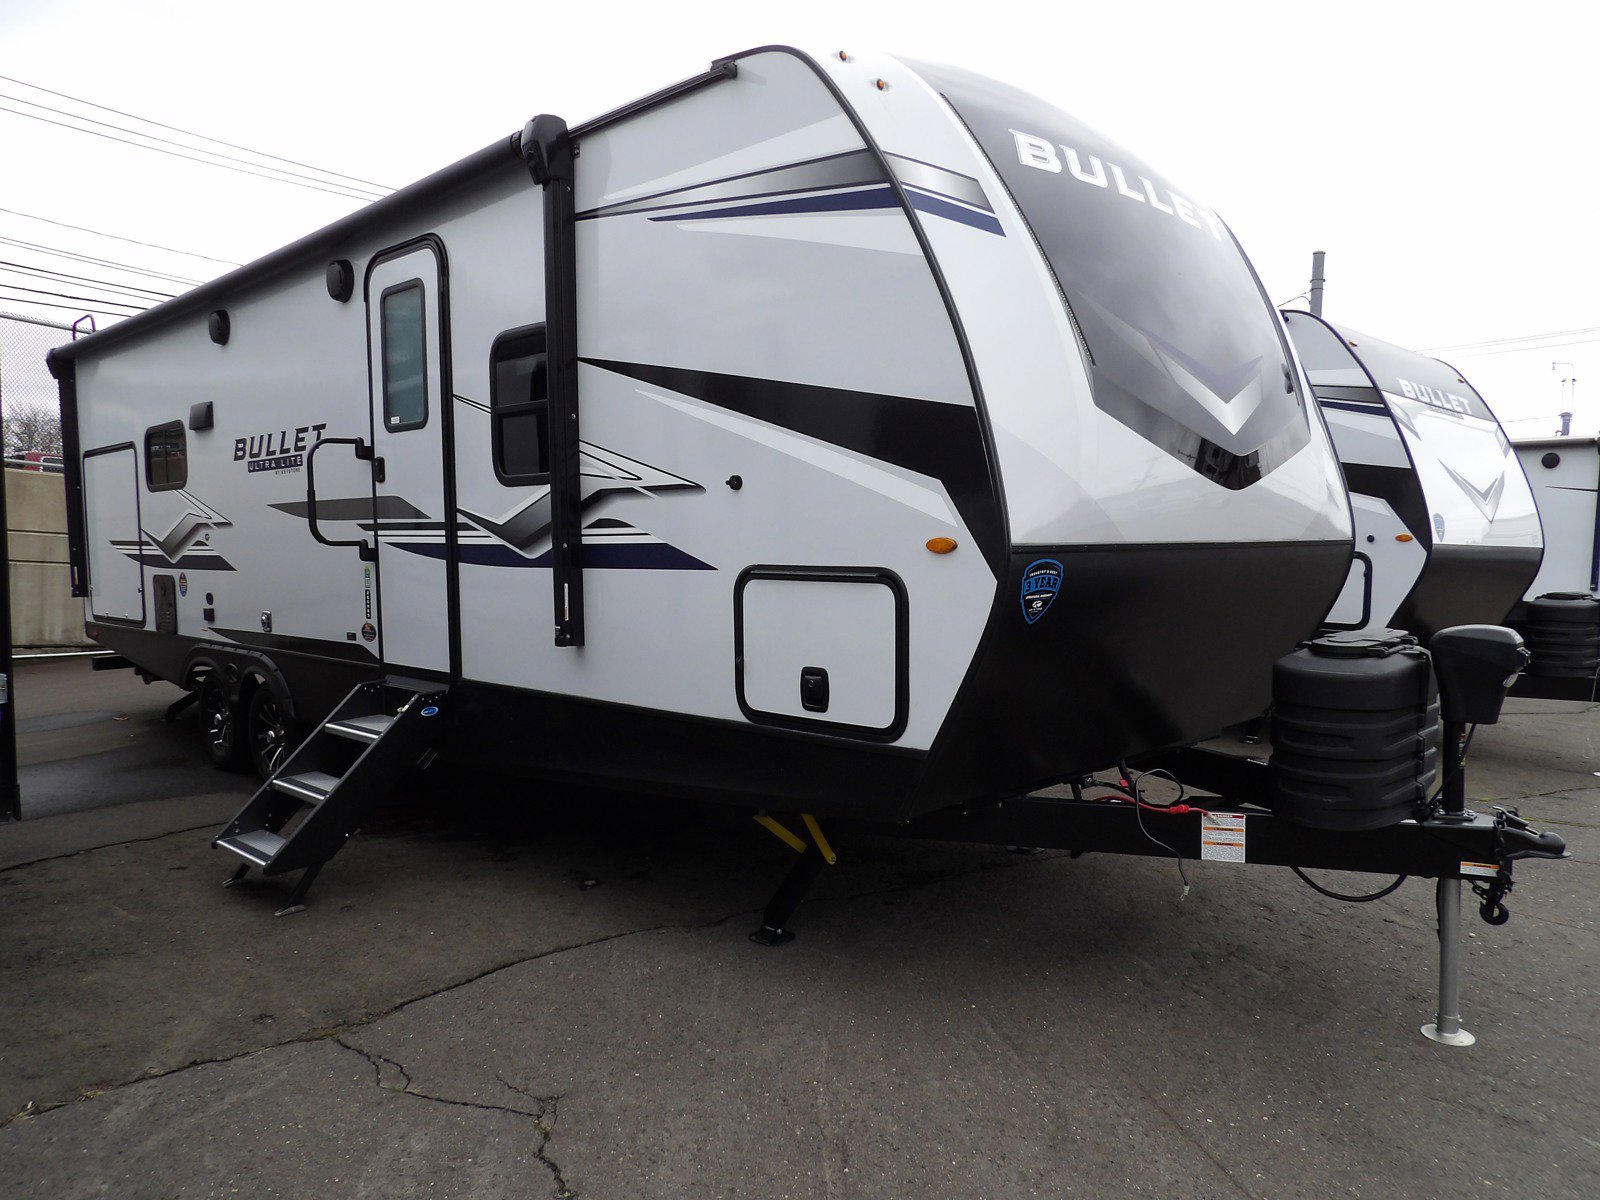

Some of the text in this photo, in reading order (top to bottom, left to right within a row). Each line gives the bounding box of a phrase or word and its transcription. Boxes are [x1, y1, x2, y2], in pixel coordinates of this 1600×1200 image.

[1008, 128, 1222, 241] BULLET
[1396, 377, 1472, 414] BULLET
[233, 423, 327, 461] BULLET
[249, 456, 302, 470] ULTRA LITE
[1025, 576, 1059, 592] 3 YEAR
